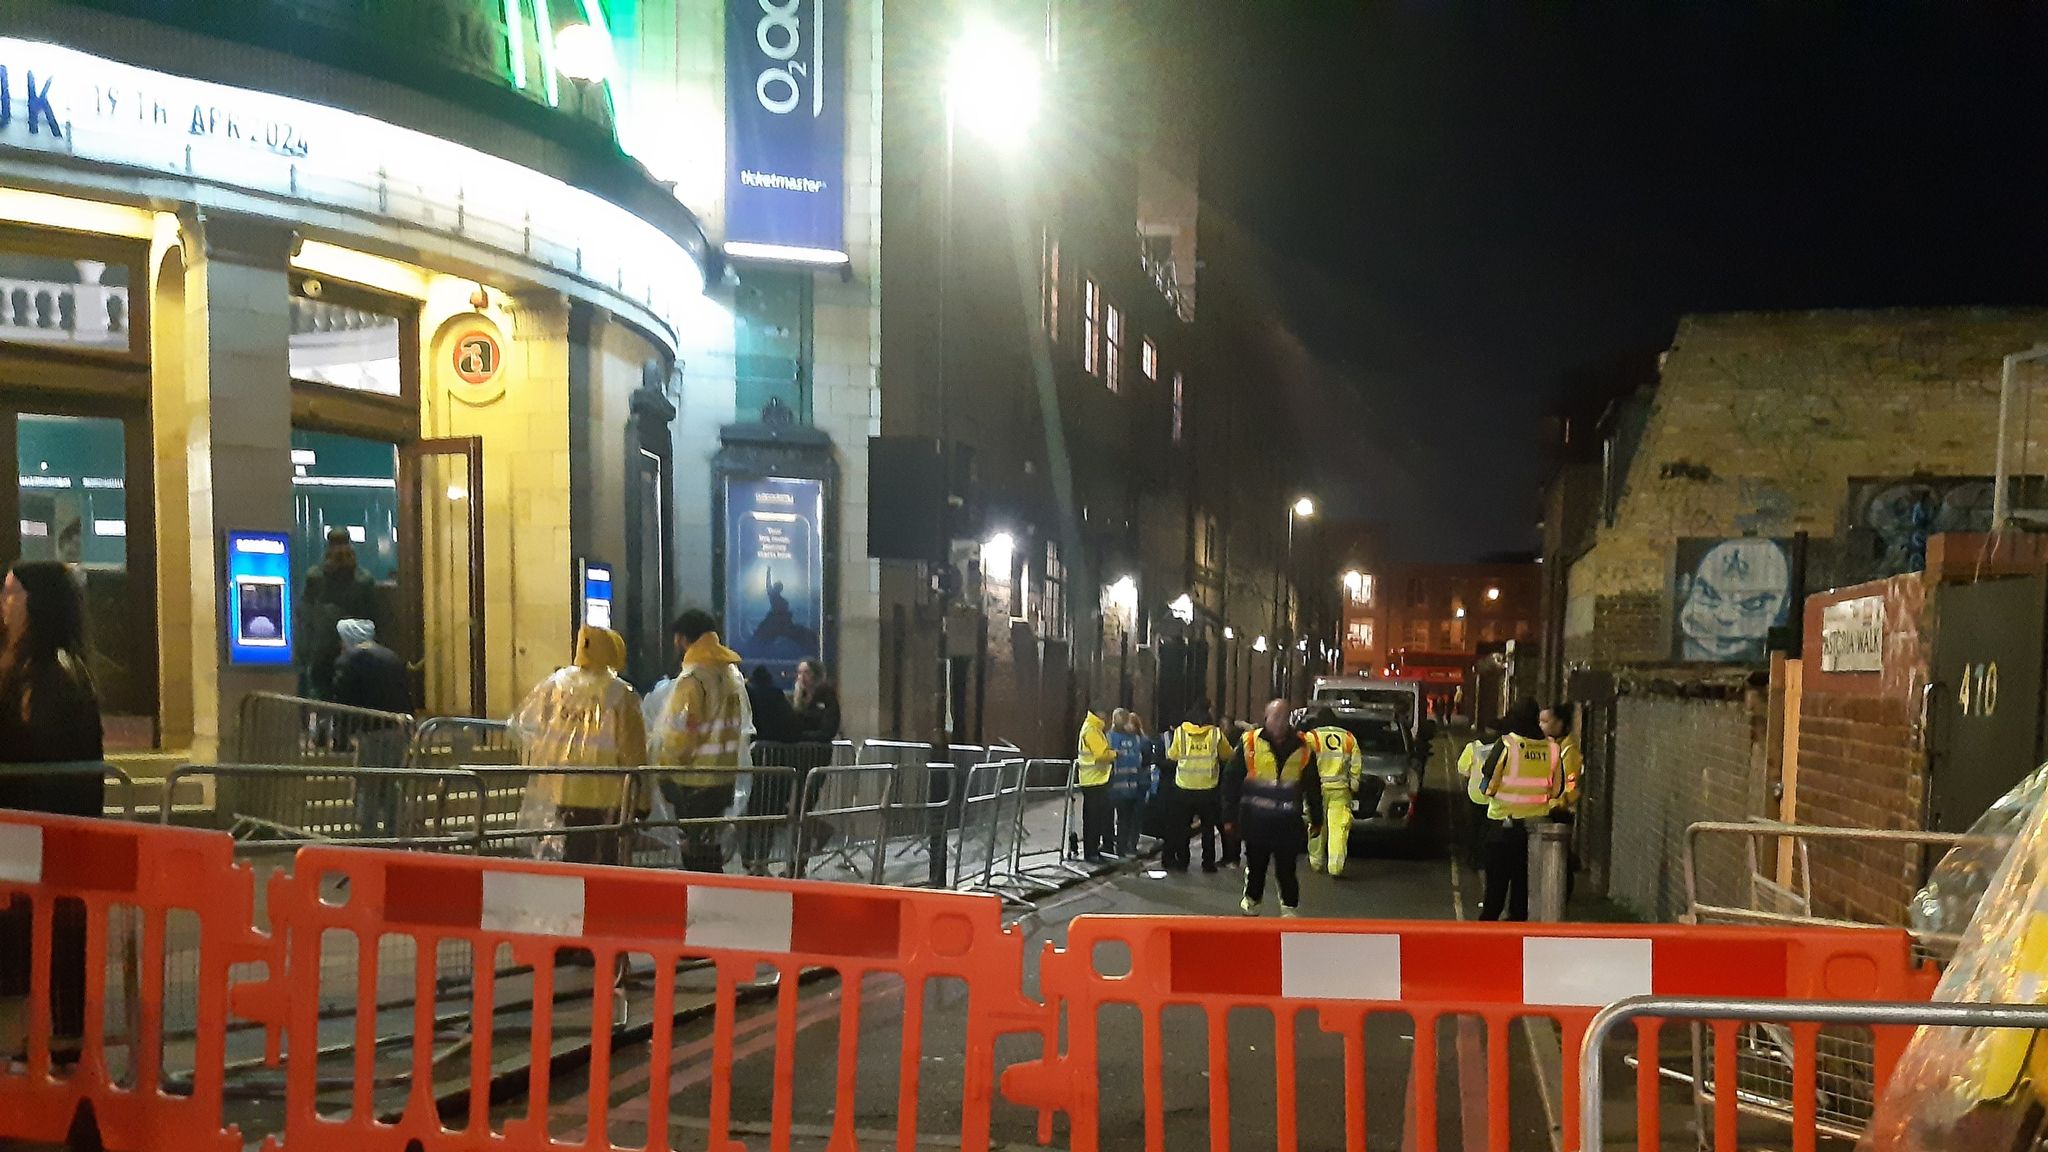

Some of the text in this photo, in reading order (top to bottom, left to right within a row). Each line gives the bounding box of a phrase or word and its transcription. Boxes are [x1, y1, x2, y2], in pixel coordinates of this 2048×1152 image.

[188, 104, 242, 140] APR
[1856, 628, 1881, 654] WALK
[1959, 662, 1998, 716] 410
[1524, 750, 1547, 761] 4031
